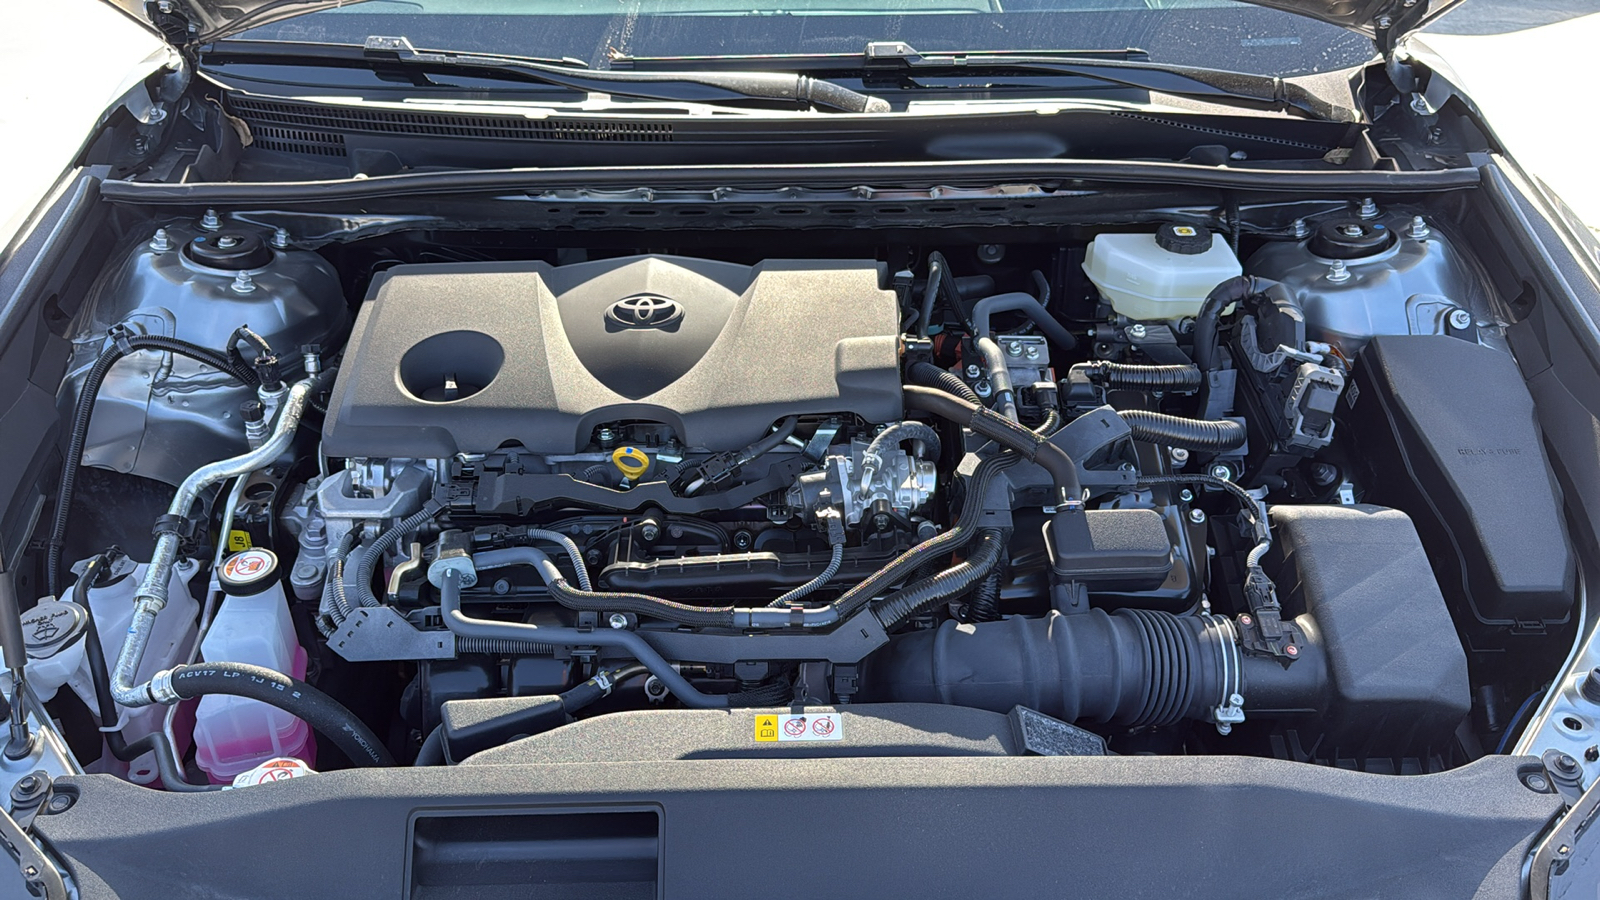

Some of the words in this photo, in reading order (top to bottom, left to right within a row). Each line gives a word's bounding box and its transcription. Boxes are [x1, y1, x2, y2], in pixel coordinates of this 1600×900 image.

[234, 536, 246, 547] J8
[178, 670, 216, 679] ACV17
[251, 676, 265, 684] 1J
[352, 731, 380, 763] YOKOHAMA
